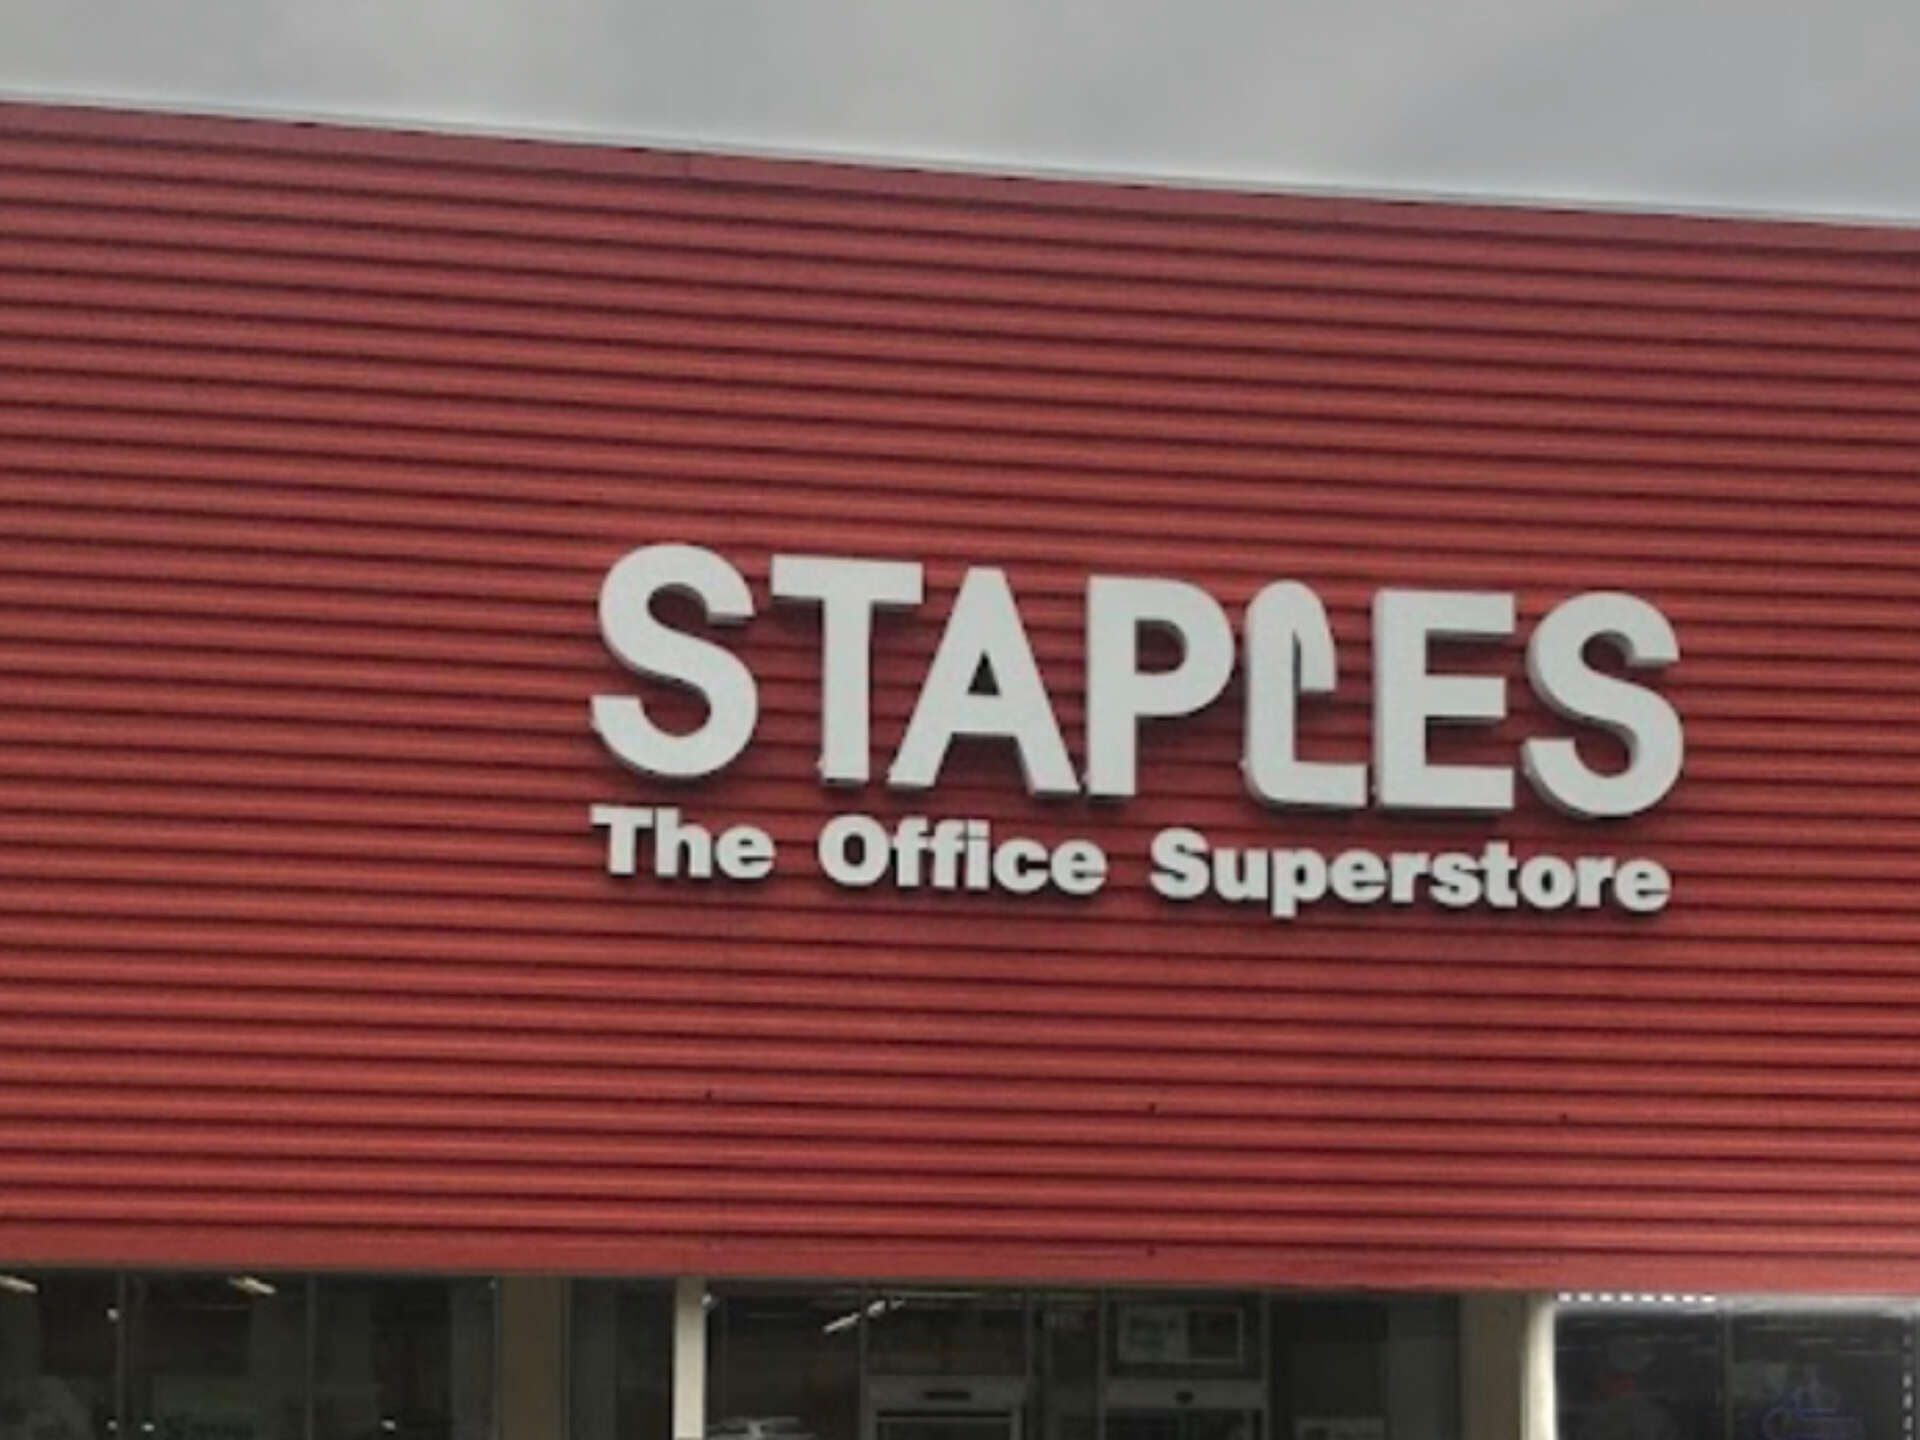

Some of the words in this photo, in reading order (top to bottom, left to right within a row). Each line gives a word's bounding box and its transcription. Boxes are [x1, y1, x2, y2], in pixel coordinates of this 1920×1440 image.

[591, 544, 1684, 816] STAPLES
[590, 804, 775, 880] The
[819, 814, 1107, 895] Office
[1150, 829, 1671, 918] Superstore
